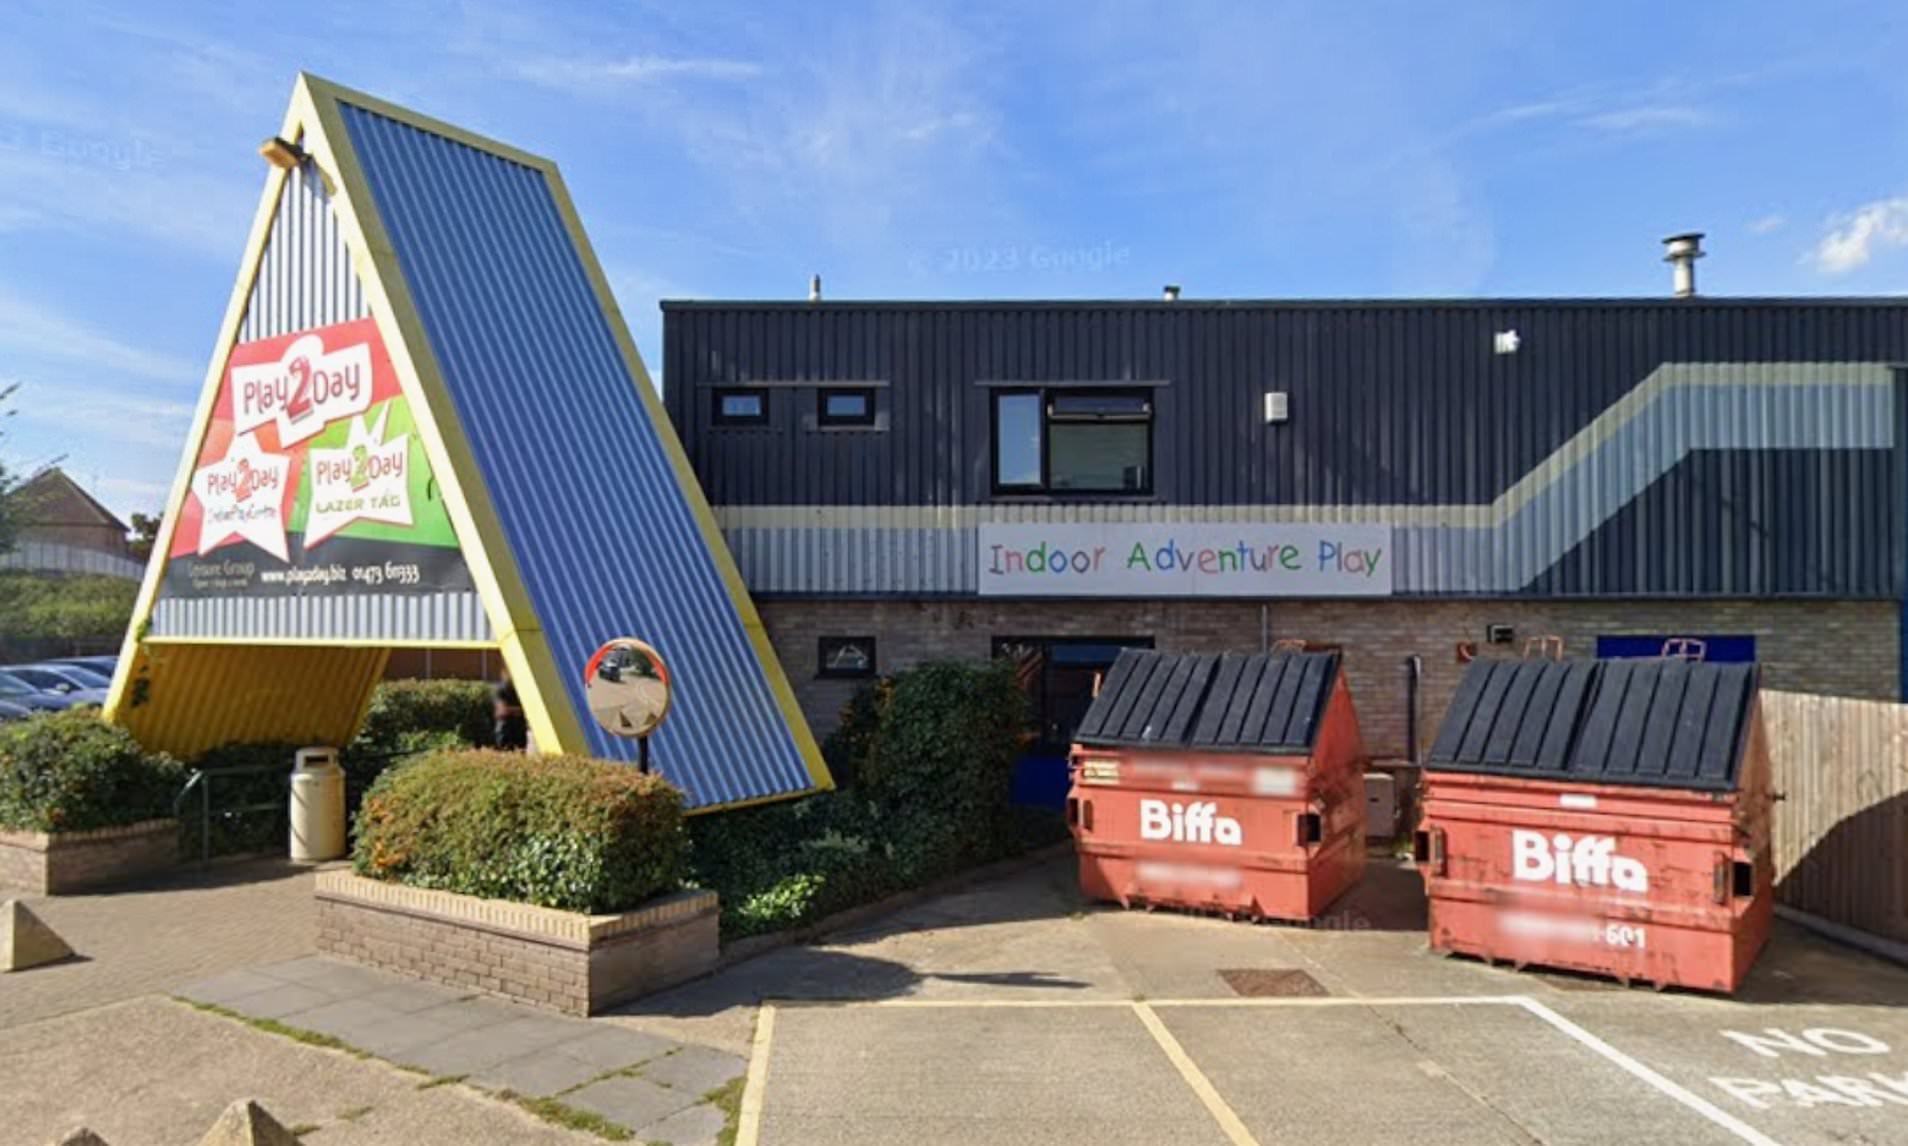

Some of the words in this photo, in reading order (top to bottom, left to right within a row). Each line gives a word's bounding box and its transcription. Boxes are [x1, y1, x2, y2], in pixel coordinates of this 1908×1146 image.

[315, 497, 365, 515] LAZER
[989, 543, 1106, 574] Indoor
[1127, 539, 1303, 573] Adventure
[1318, 540, 1382, 577] Play
[1139, 798, 1243, 846] Biffa
[1512, 830, 1649, 892] Biffa
[1718, 1027, 1891, 1058] NO
